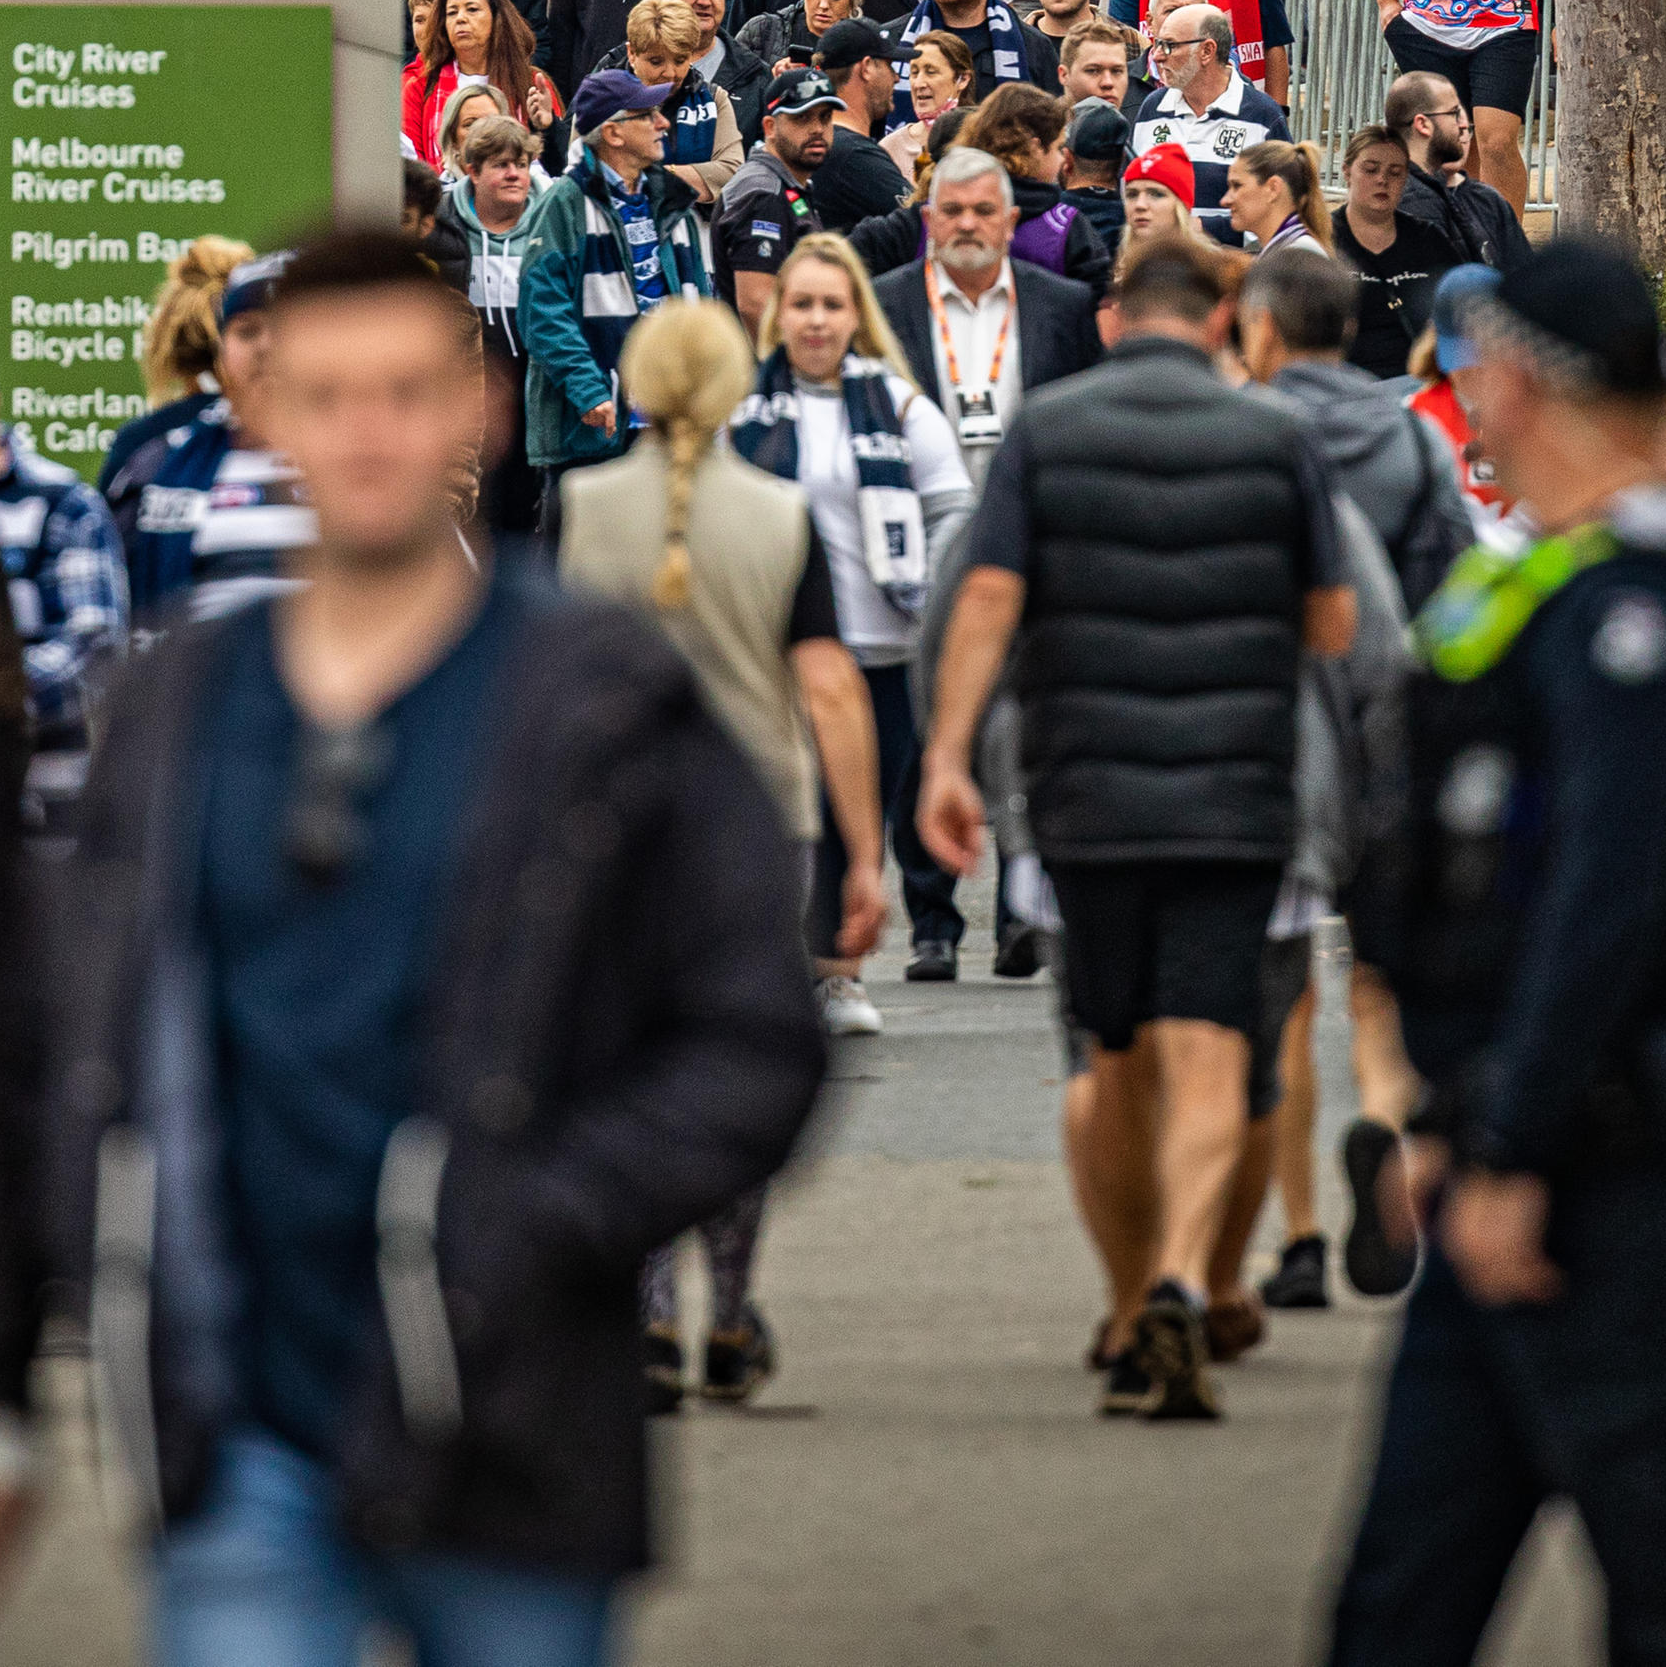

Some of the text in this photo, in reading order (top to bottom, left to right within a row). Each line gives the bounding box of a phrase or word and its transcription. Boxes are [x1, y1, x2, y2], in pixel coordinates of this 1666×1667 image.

[13, 43, 167, 80] City River
[13, 77, 135, 108] Cruises
[12, 137, 184, 168] Melbourne
[1219, 129, 1243, 148] GFC
[12, 171, 225, 203] River Cruises
[11, 232, 129, 269] Pilgrim
[11, 295, 151, 326] Rentabik
[11, 330, 125, 368] Bicycle
